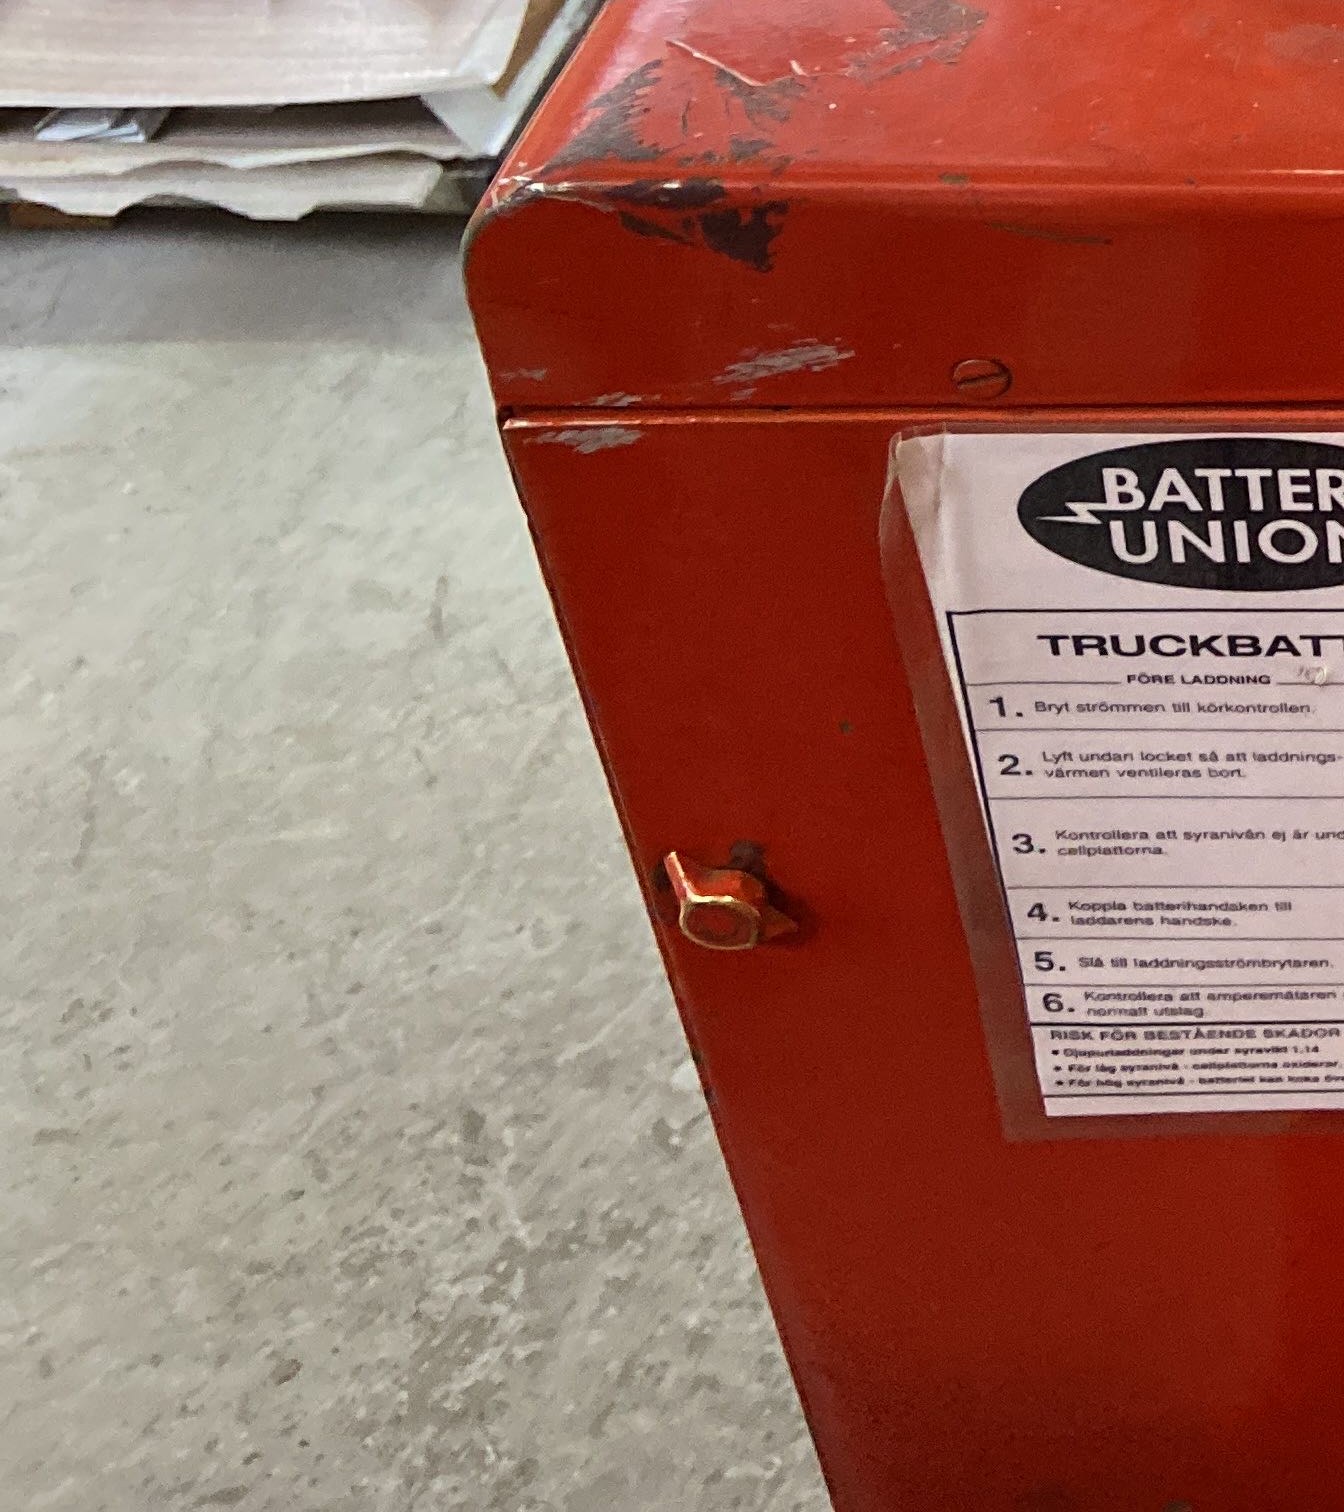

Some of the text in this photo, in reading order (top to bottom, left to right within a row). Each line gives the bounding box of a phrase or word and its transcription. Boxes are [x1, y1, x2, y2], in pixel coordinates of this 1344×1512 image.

[1126, 672, 1272, 686] FÖRE LADDNING
[988, 694, 1024, 719] 1.
[1034, 701, 1071, 716] Bryt
[1075, 701, 1166, 714] strömmen
[1171, 701, 1191, 714] till
[997, 749, 1343, 776] 2. Lyft undan locket så att laddnings-
[1043, 767, 1111, 779] värmen
[1115, 766, 1203, 779] ventileras
[1011, 833, 1047, 855] 3.
[1054, 830, 1150, 841] Kontrollera
[1155, 830, 1178, 840] att
[1182, 829, 1266, 842] syranivån
[1271, 831, 1287, 842] ej
[1292, 829, 1309, 840] är
[1026, 900, 1293, 922] 4. Koppla batterihandsken till
[1070, 915, 1155, 926] laddarens
[1034, 950, 1067, 973] 5.
[1078, 956, 1105, 968] Slå
[1110, 957, 1128, 968] till
[1042, 991, 1076, 1014] 6.
[1083, 989, 1176, 1003] Kontrollera
[1178, 992, 1201, 1002] att
[1086, 1007, 1150, 1018] normalt
[1050, 1026, 1341, 1041] RISK FÖR BESTÅENDE SKADOR
